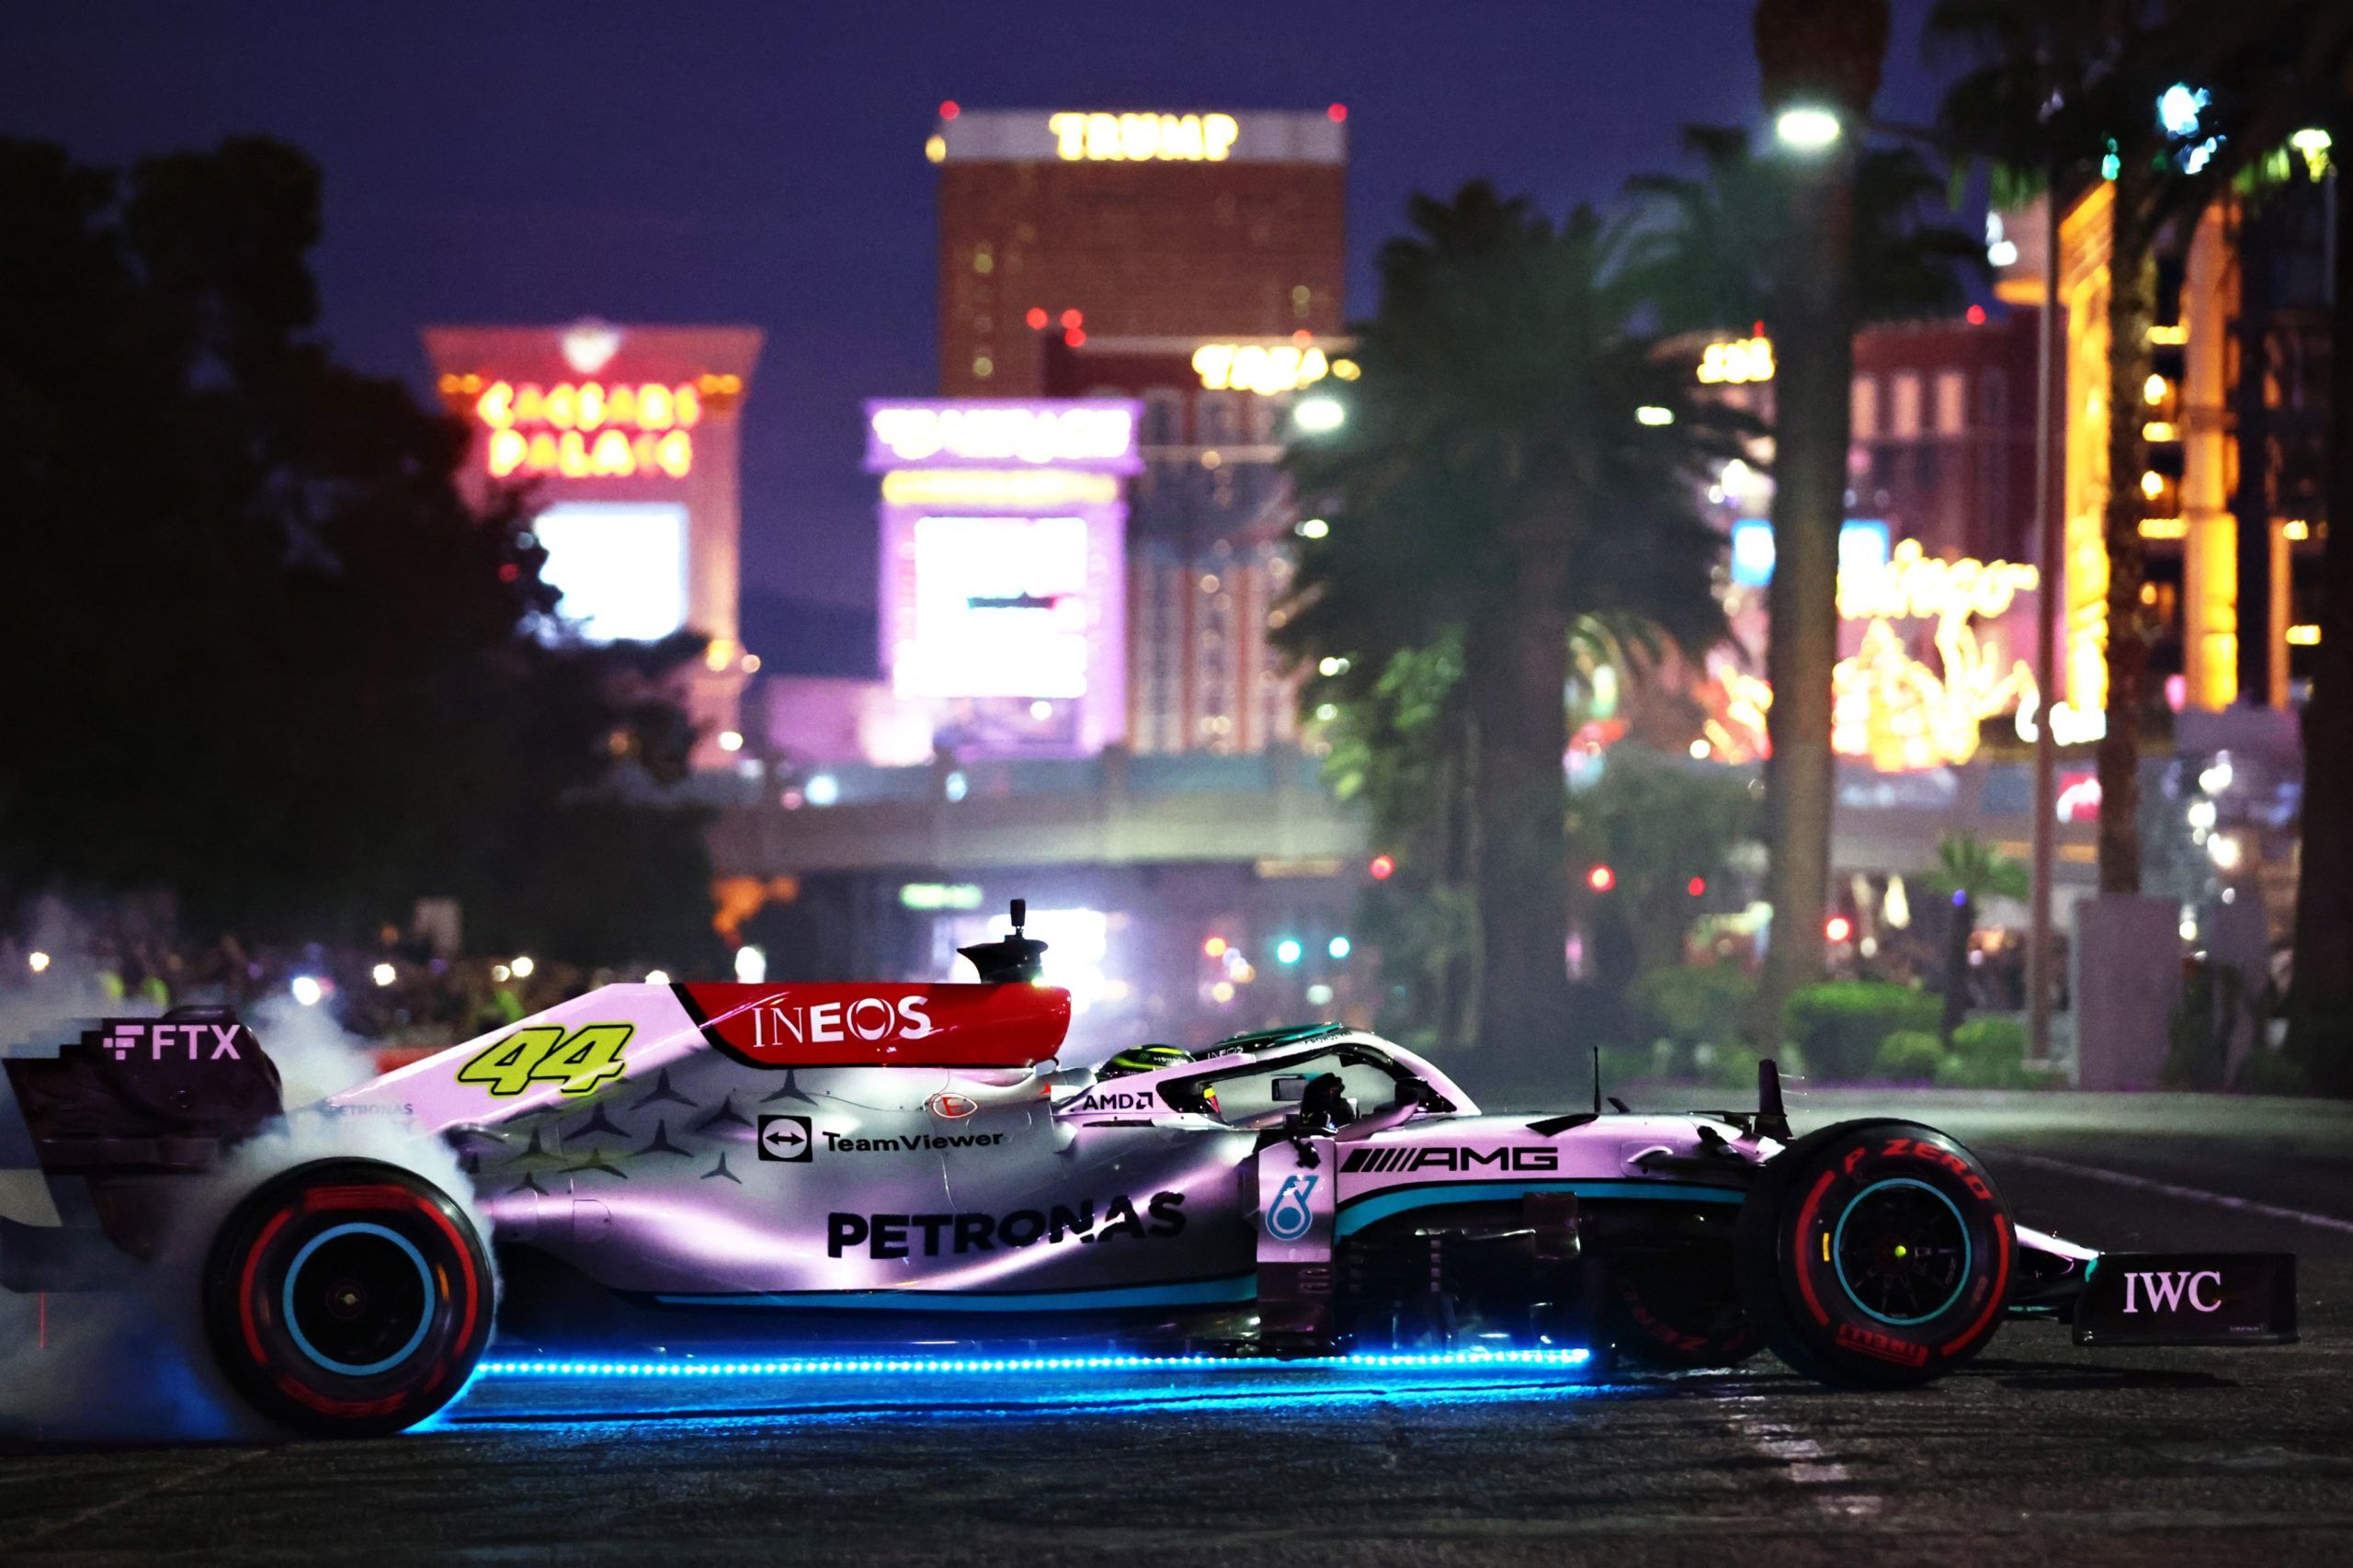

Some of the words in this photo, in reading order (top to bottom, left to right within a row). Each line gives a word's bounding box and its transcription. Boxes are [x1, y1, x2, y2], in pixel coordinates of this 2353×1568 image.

[1049, 112, 1239, 162] TRUMP
[152, 1024, 241, 1060] FTX
[752, 995, 934, 1048] INEOS
[457, 1022, 633, 1098] 44
[1082, 1093, 1134, 1111] AMD
[822, 1131, 1005, 1153] TeamViewer
[1406, 1147, 1559, 1172] AMG
[1882, 1138, 1994, 1200] ZERO
[827, 1191, 1187, 1260] PETRONAS
[2122, 1270, 2222, 1313] IWC
